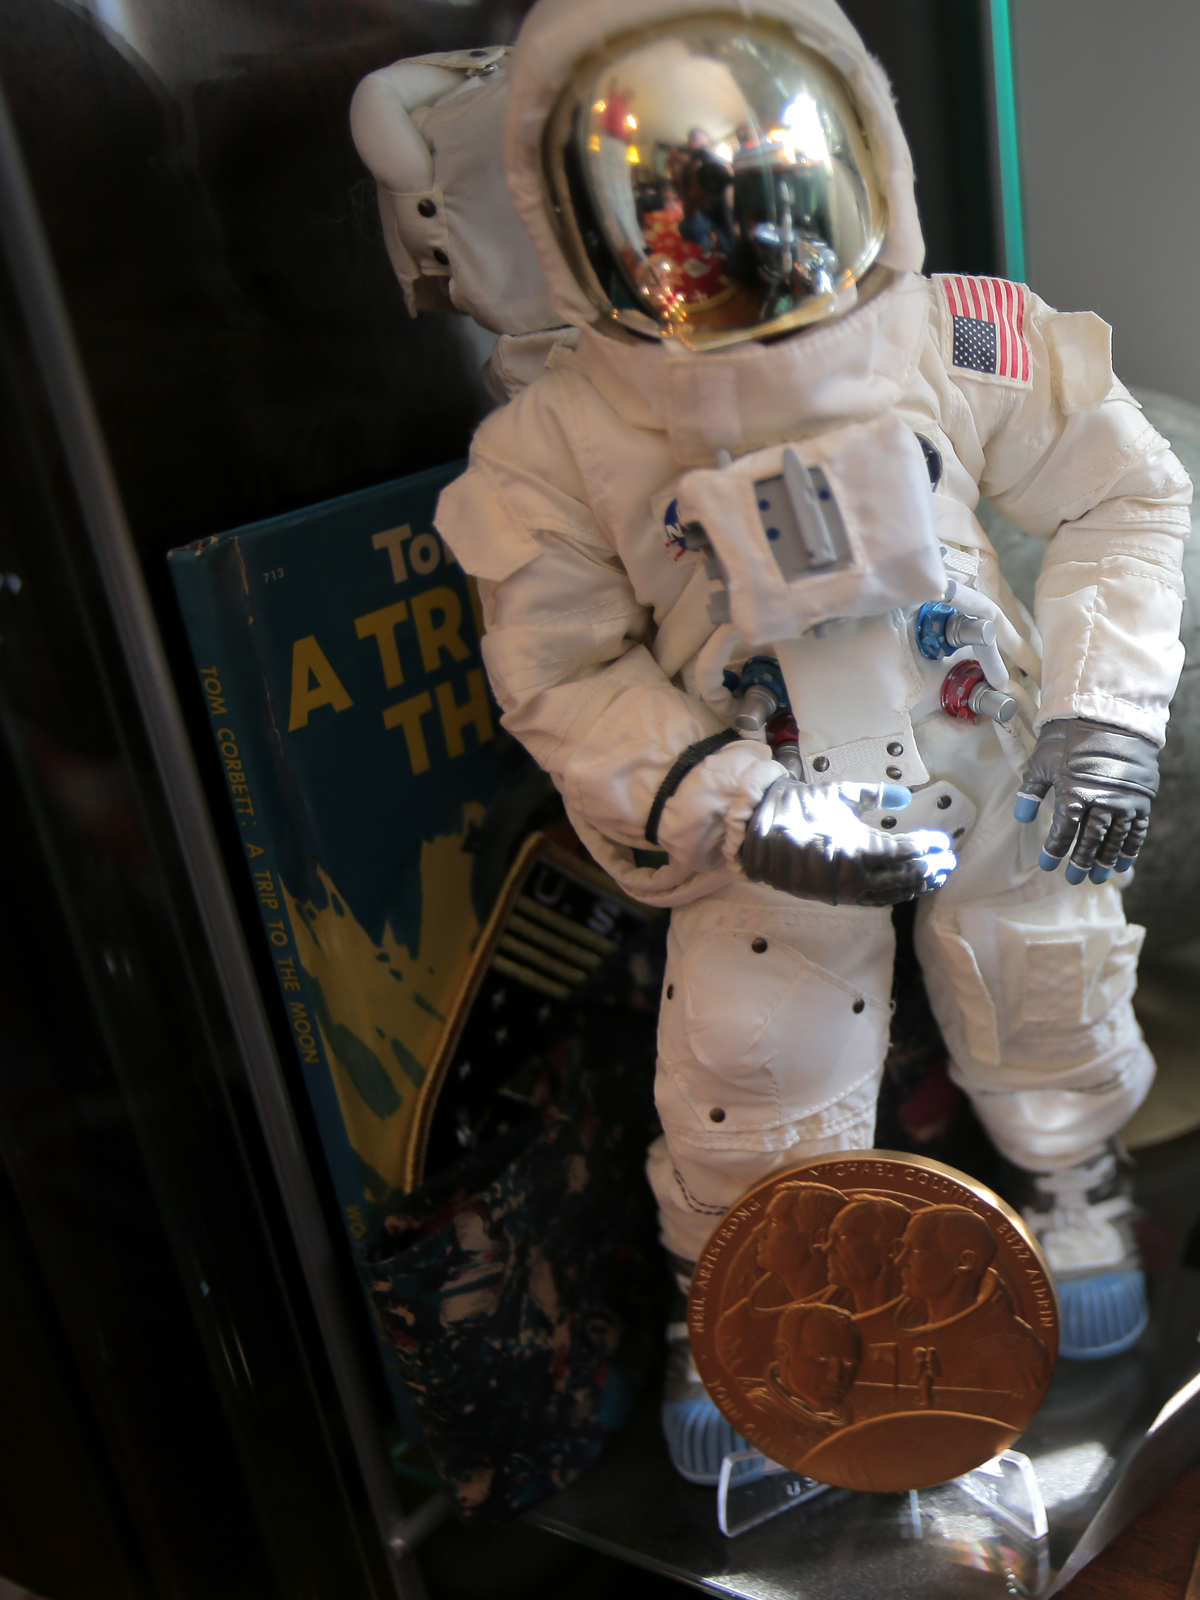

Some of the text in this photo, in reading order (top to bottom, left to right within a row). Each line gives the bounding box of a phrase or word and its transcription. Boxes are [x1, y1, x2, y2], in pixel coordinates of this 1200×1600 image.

[263, 567, 285, 583] 713
[371, 523, 456, 584] To
[288, 634, 355, 732] A
[382, 667, 495, 777] TH
[200, 665, 320, 1066] TOM CORBETT: A TRIP TO THE MOON
[808, 1162, 980, 1208] MICHAEL COLLINS
[691, 1198, 763, 1333] NEIL ARMSTRONG
[996, 1222, 1056, 1328] BUZZ ALDRIN
